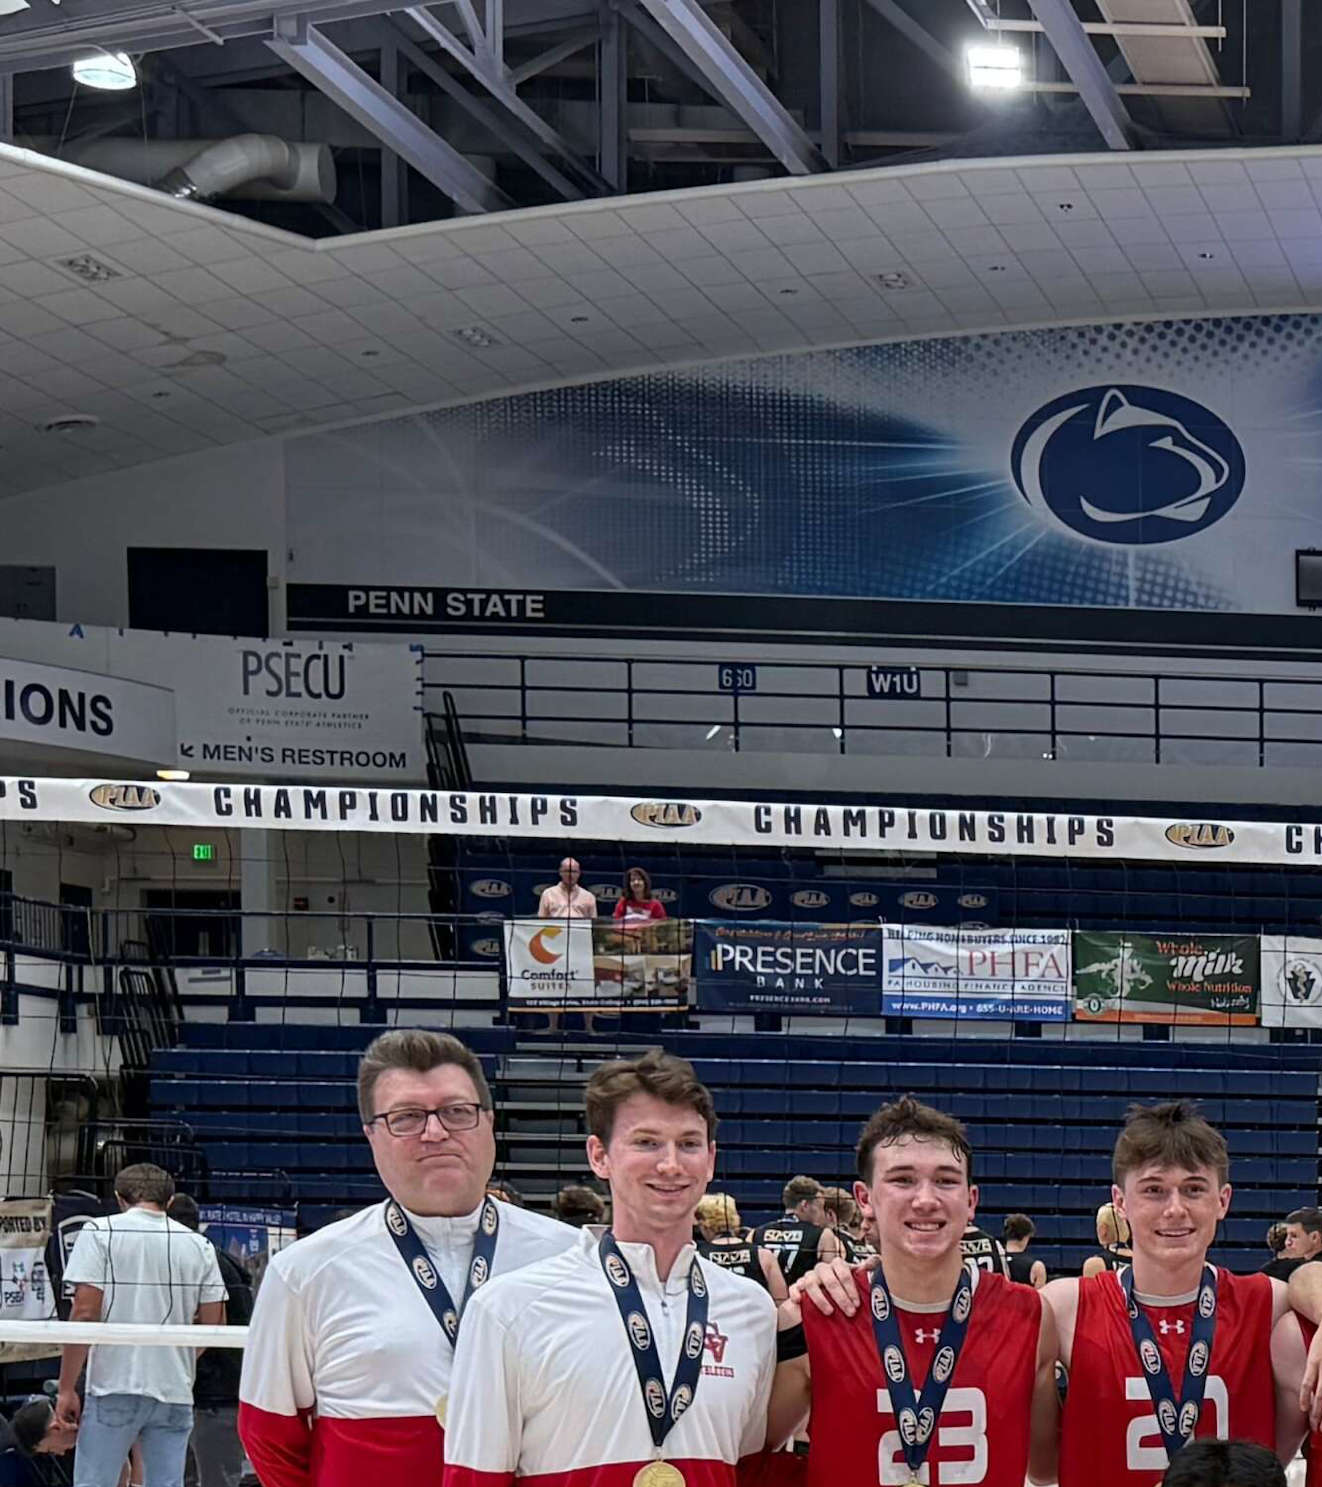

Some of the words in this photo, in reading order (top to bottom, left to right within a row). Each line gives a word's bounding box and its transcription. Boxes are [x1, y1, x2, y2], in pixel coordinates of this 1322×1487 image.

[347, 591, 433, 616] PENN
[445, 593, 546, 619] STATE
[241, 650, 346, 700] PSECU
[871, 673, 918, 693] W1U
[203, 743, 276, 764] MEN'S
[281, 746, 408, 769] RESTROOM
[214, 788, 578, 827] CHAMPIONSHIPS
[755, 806, 1114, 847] CHAMPIONSHIPS
[1170, 823, 1232, 846] PIAA
[714, 943, 877, 977] PRESENCE
[967, 950, 1065, 979] PHFA
[521, 968, 577, 981] Comfort
[756, 976, 824, 990] BANK
[877, 1387, 989, 1487] 23
